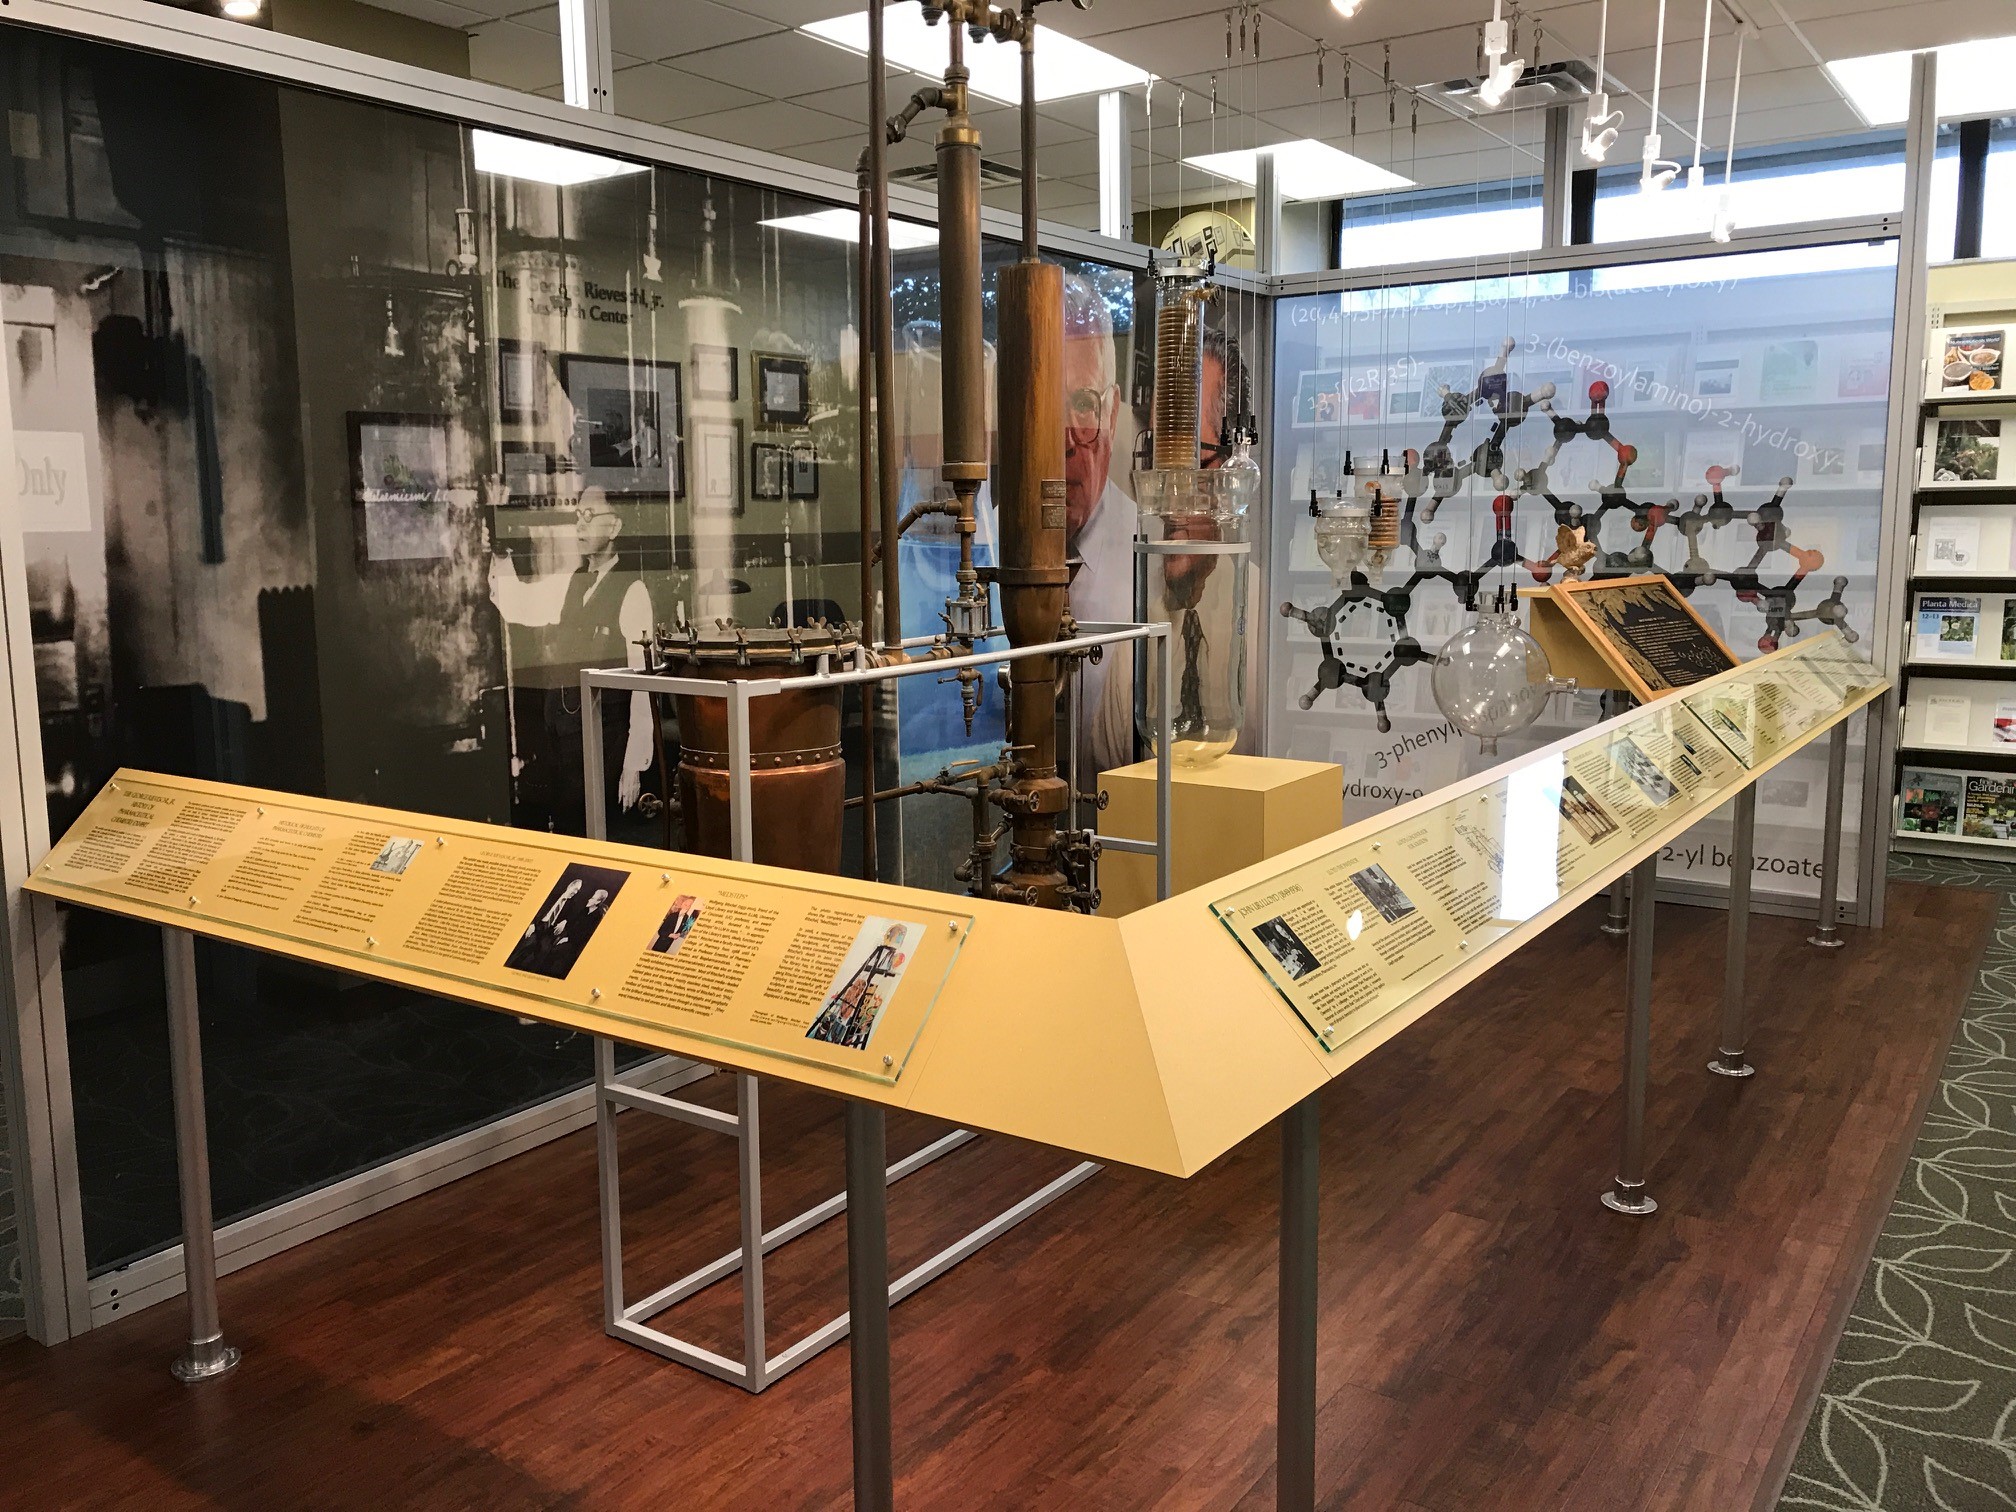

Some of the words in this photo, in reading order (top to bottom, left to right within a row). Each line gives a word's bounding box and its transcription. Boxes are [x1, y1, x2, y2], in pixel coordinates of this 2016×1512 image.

[1922, 600, 1947, 608] Planta
[1948, 600, 1978, 608] Medica
[1236, 903, 1257, 918] JOHN
[1260, 892, 1281, 906] LLOYD
